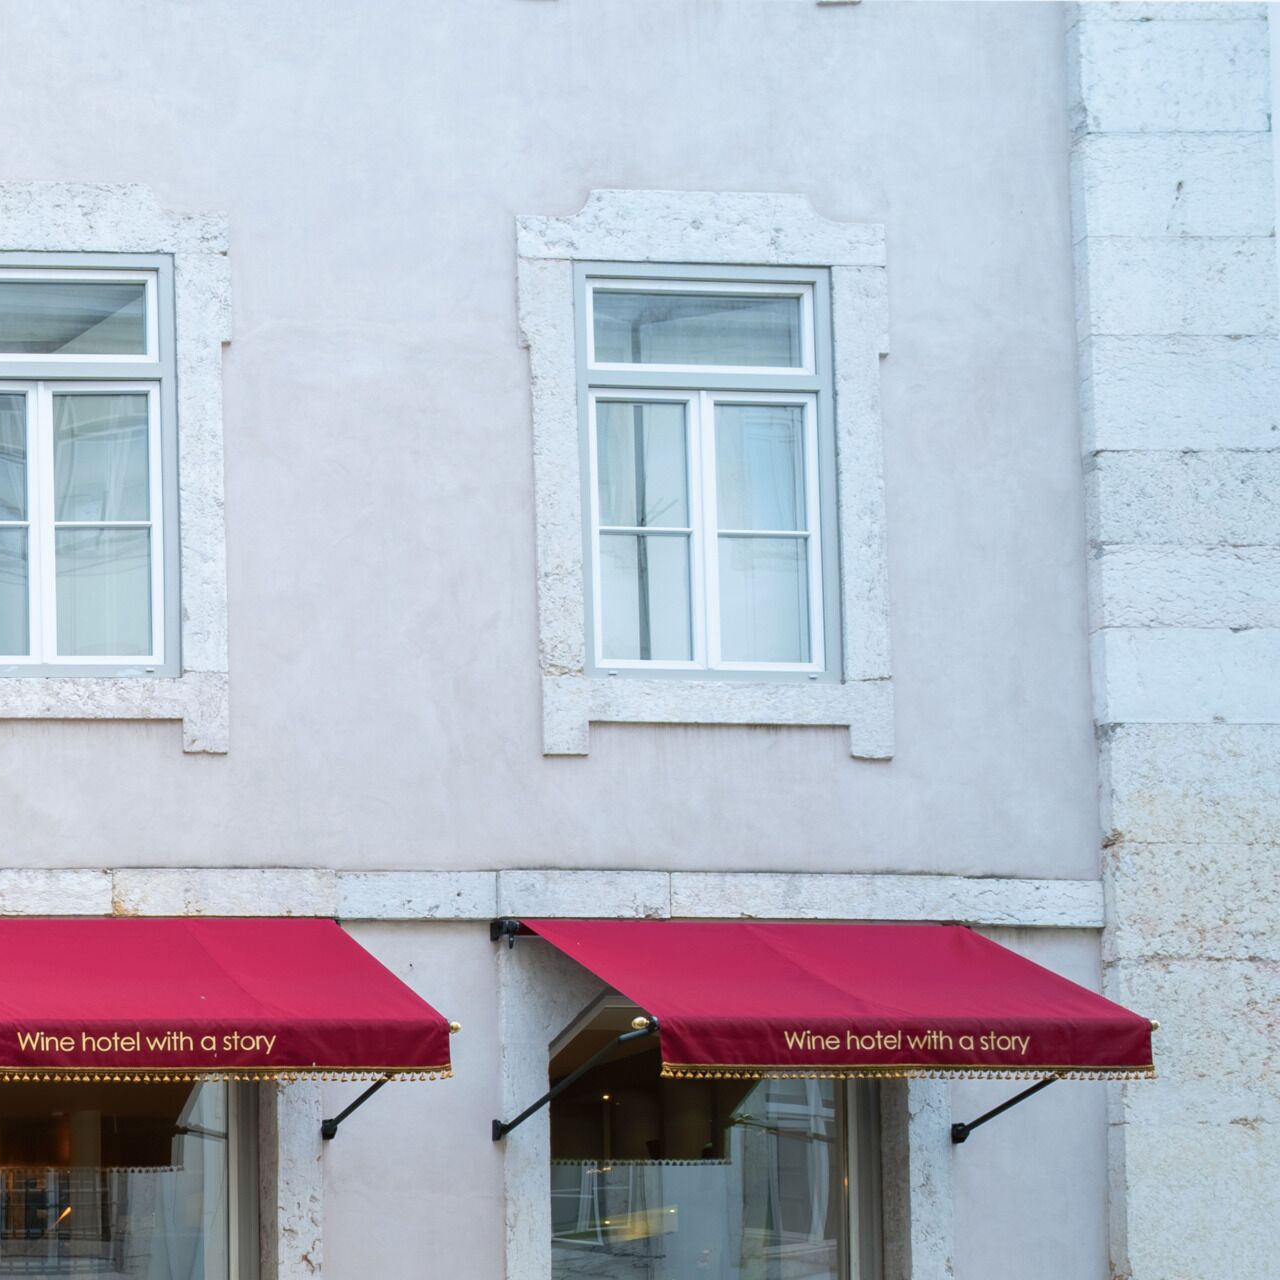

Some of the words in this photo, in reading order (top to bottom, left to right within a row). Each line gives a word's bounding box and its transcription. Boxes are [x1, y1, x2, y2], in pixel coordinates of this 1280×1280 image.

[17, 1032, 75, 1052] Wine
[82, 1031, 141, 1052] hotel
[146, 1031, 194, 1052] with
[201, 1036, 217, 1052] a
[223, 1033, 277, 1055] story
[785, 1031, 840, 1050] Wine
[847, 1030, 902, 1050] hotel
[907, 1030, 953, 1050] with
[959, 1036, 975, 1050] a
[980, 1032, 1030, 1055] story
